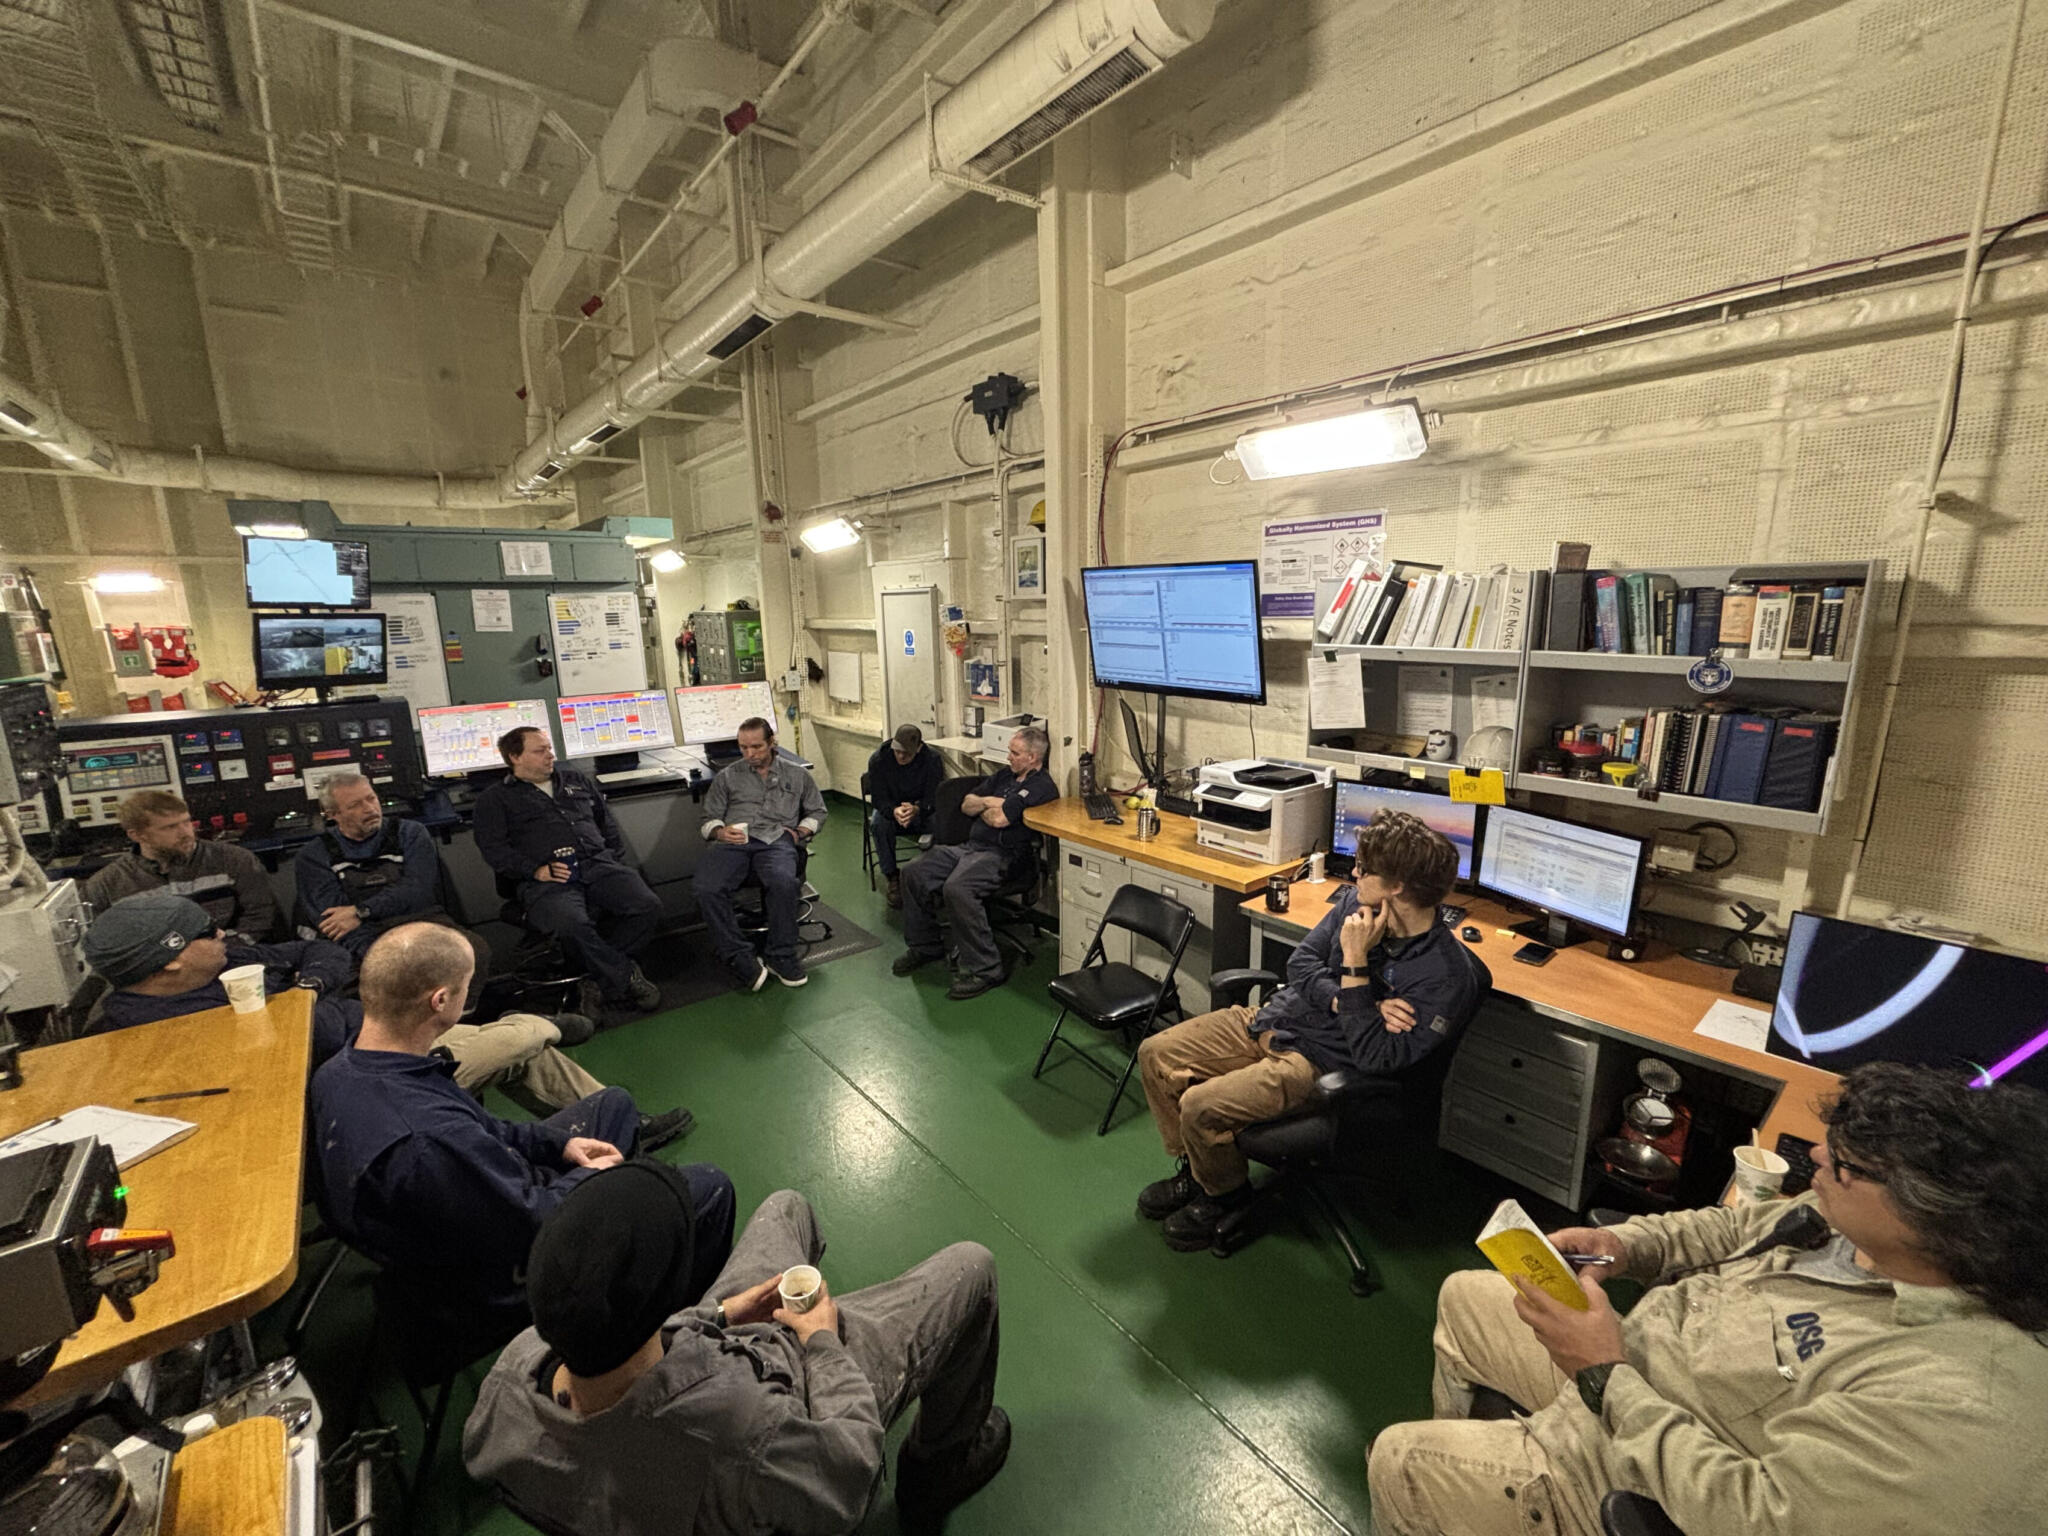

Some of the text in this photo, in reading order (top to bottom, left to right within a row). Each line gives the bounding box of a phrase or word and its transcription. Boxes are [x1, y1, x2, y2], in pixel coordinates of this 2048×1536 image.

[1269, 517, 1377, 534] Globally Harmonized System (GHS)
[1509, 597, 1522, 617] A/E
[1503, 619, 1518, 650] Notes
